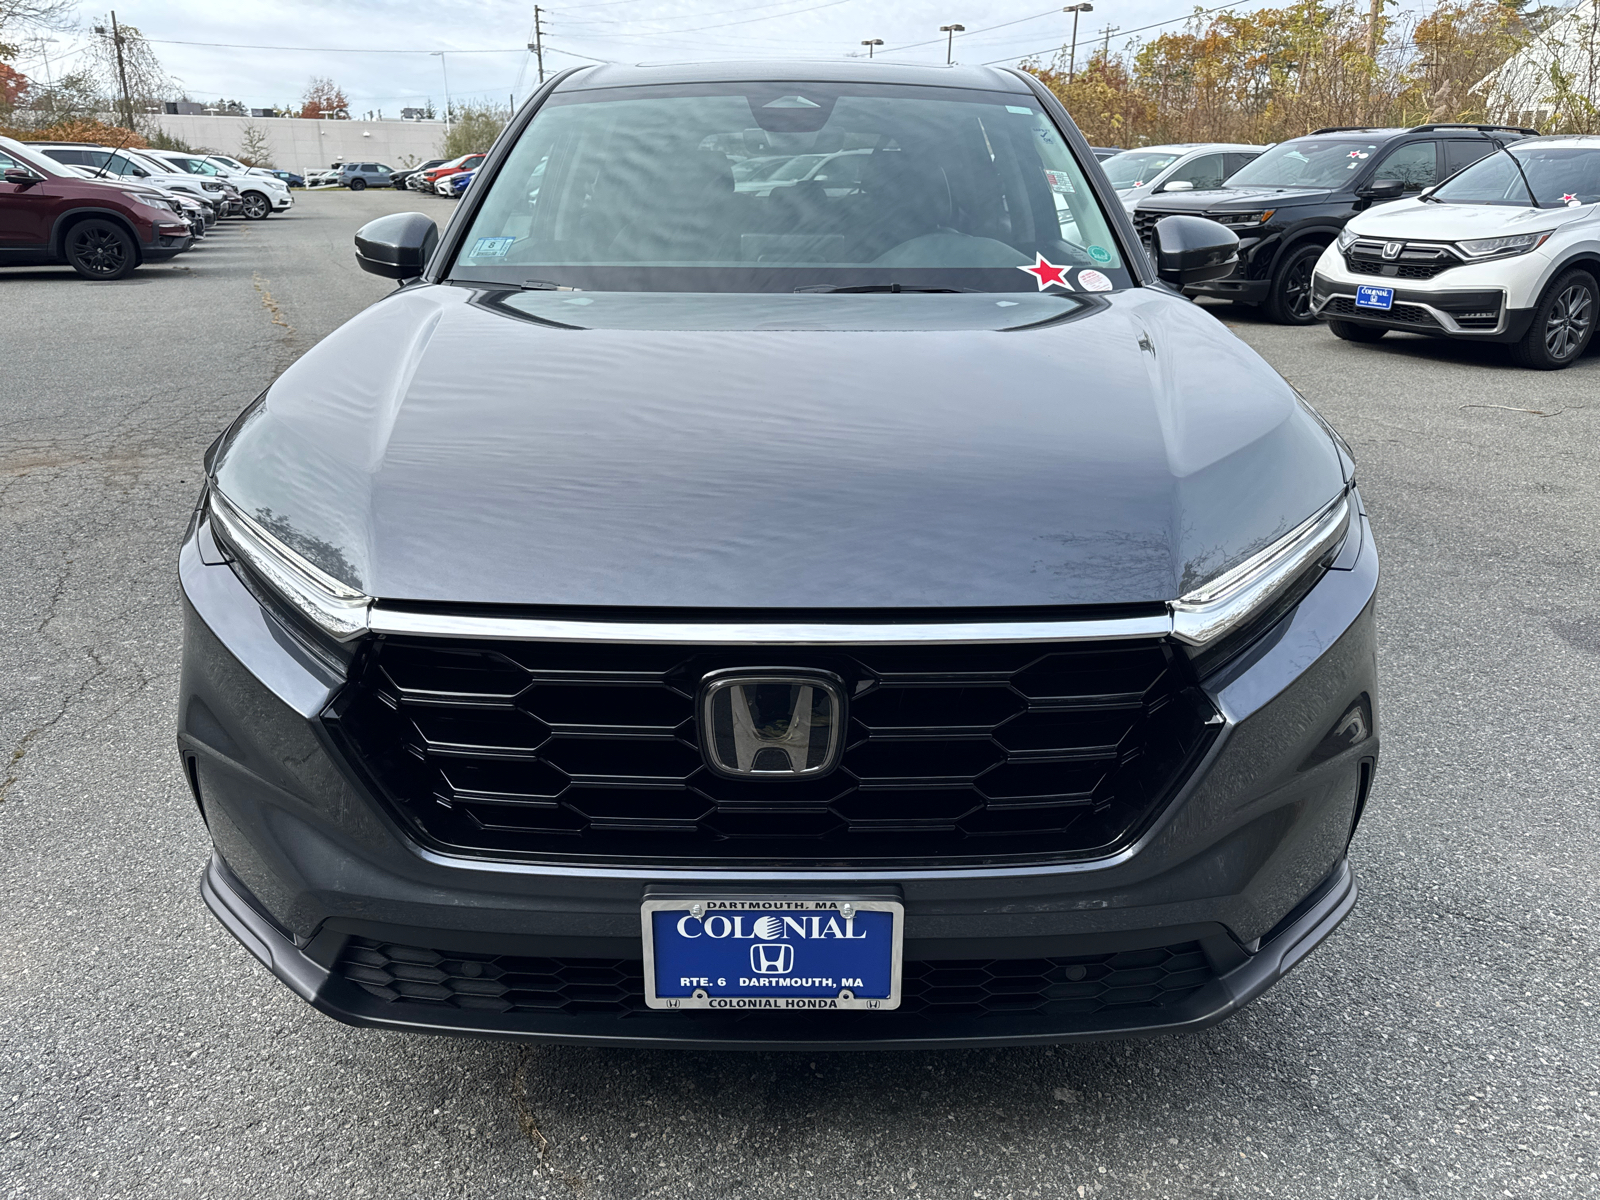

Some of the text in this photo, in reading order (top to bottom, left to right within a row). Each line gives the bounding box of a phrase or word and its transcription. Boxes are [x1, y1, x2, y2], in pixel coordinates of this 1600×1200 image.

[814, 901, 839, 910] MA
[676, 915, 867, 940] COLONIAL
[680, 977, 864, 988] RTE. 6 DARTMOUTH, MA
[708, 999, 838, 1009] COLONIAL HONDA
